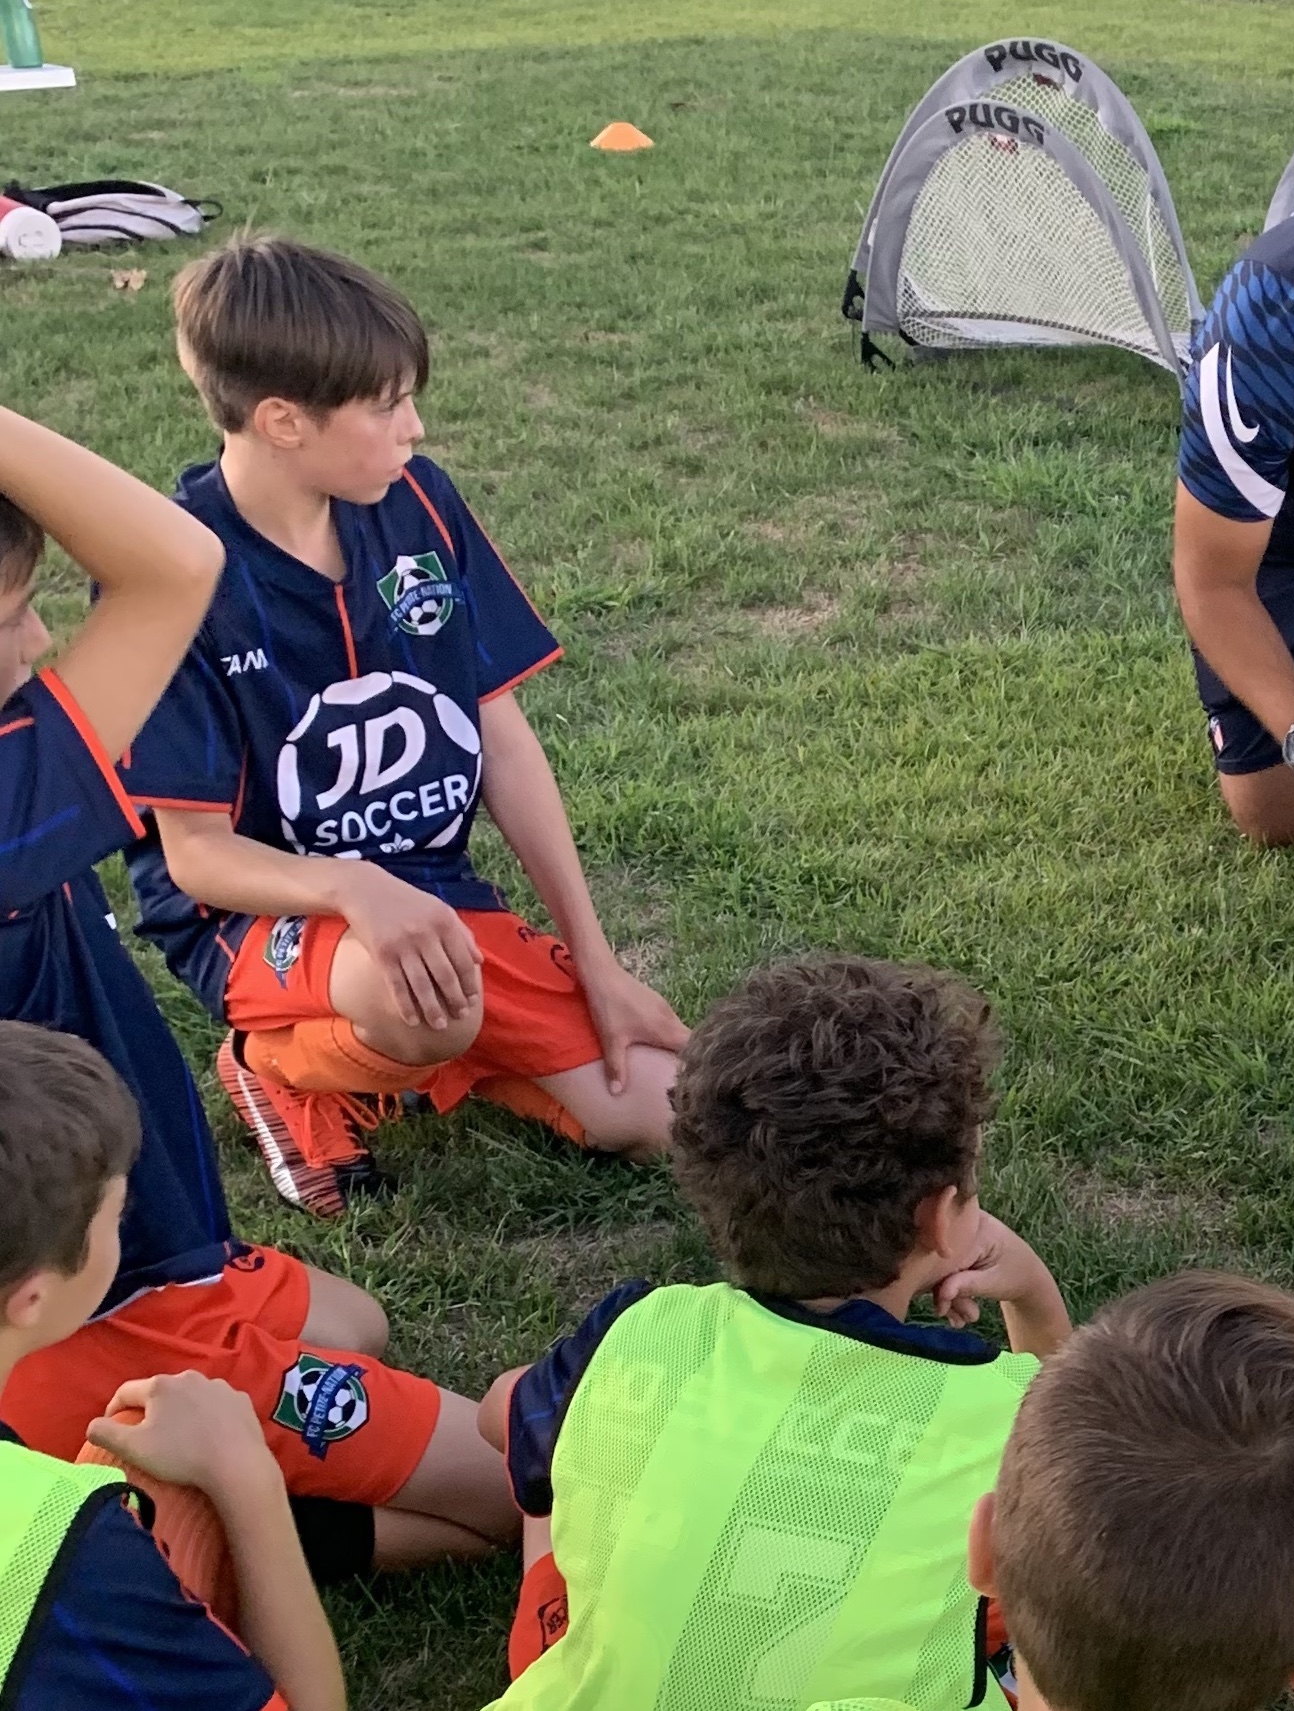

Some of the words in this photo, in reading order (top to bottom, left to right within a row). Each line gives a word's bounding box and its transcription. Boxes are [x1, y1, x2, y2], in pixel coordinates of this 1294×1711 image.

[984, 41, 1083, 83] PUGG
[945, 103, 1045, 146] PUGG
[315, 706, 427, 810] JD
[313, 773, 470, 847] SOCCER
